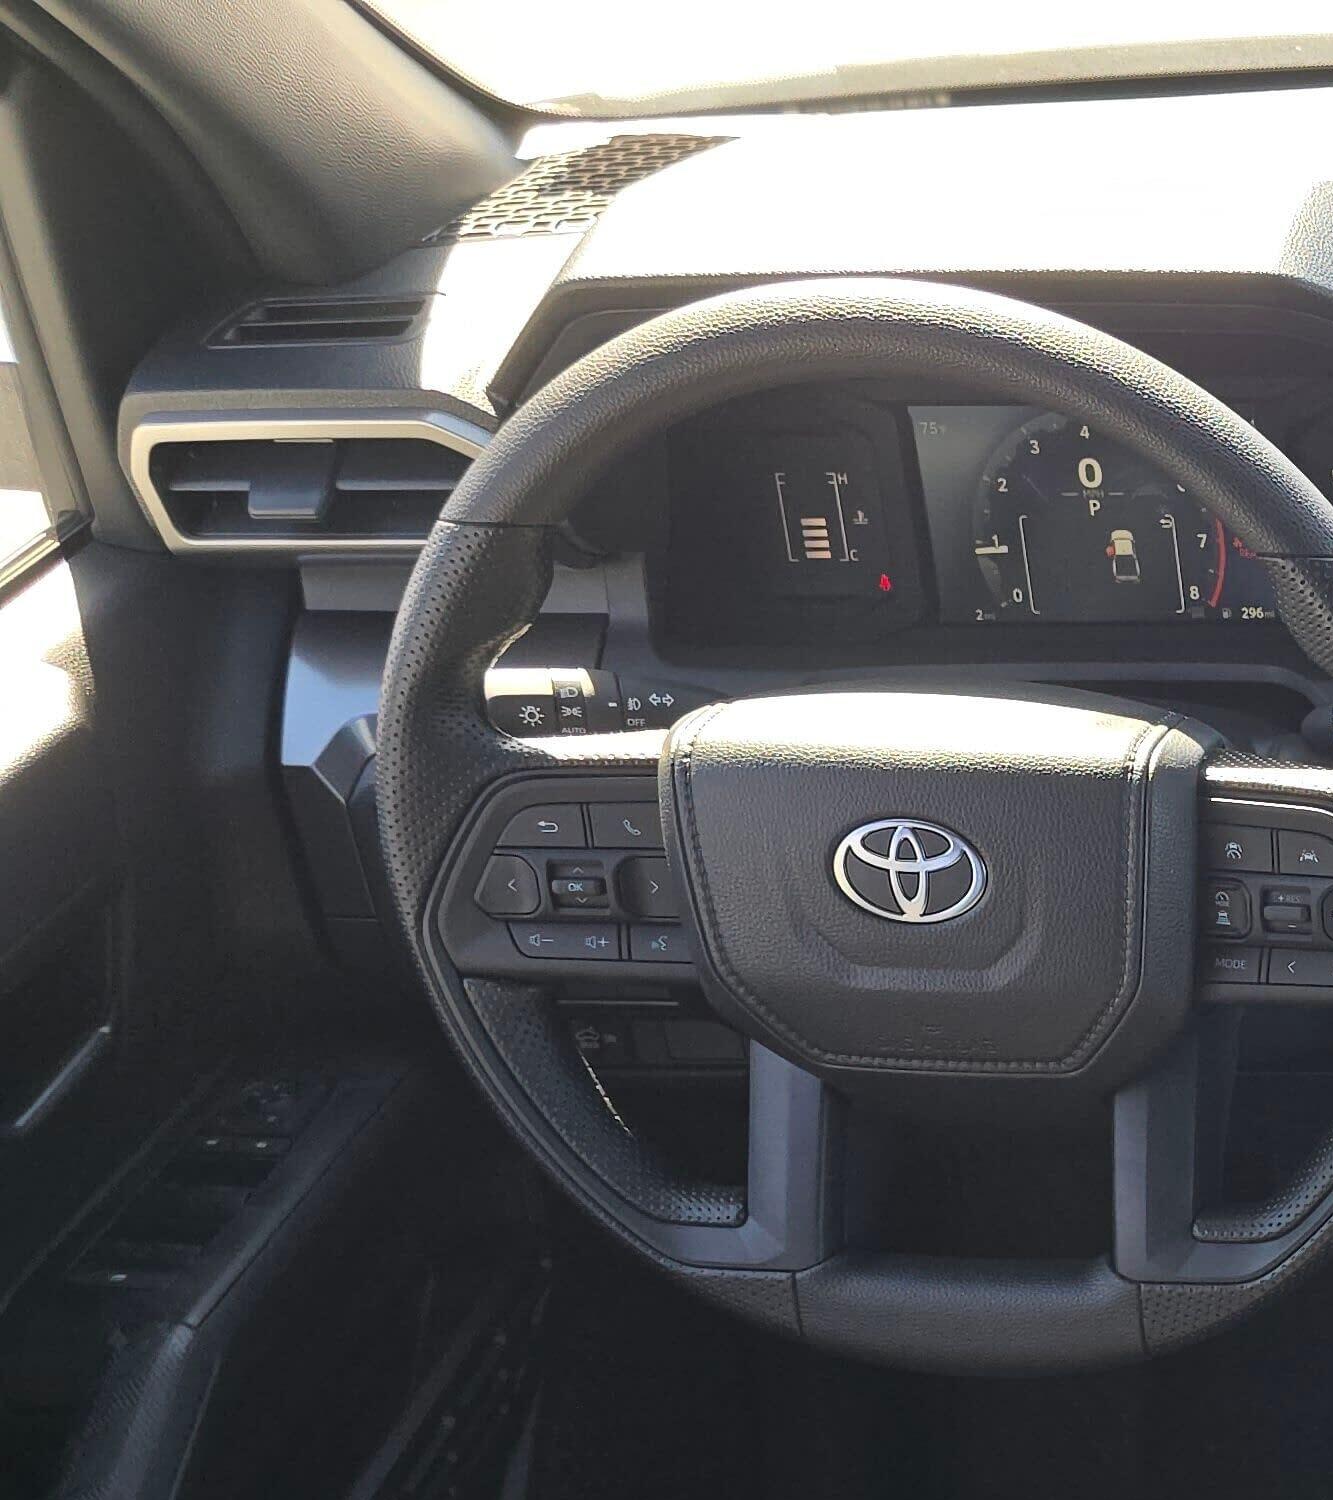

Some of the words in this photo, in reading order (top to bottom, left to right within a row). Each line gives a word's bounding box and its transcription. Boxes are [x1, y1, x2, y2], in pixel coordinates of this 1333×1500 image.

[1080, 426, 1089, 439] 4
[1030, 440, 1040, 454] 3
[1077, 457, 1103, 488] 0
[998, 478, 1008, 492] 2
[1089, 499, 1100, 516] P
[1197, 533, 1207, 548] 7
[1013, 588, 1023, 603] 0
[1190, 585, 1200, 600] 8
[1241, 607, 1264, 619] 296
[627, 718, 646, 727] OFF
[567, 882, 584, 892] OK
[1215, 958, 1247, 969] MODE
